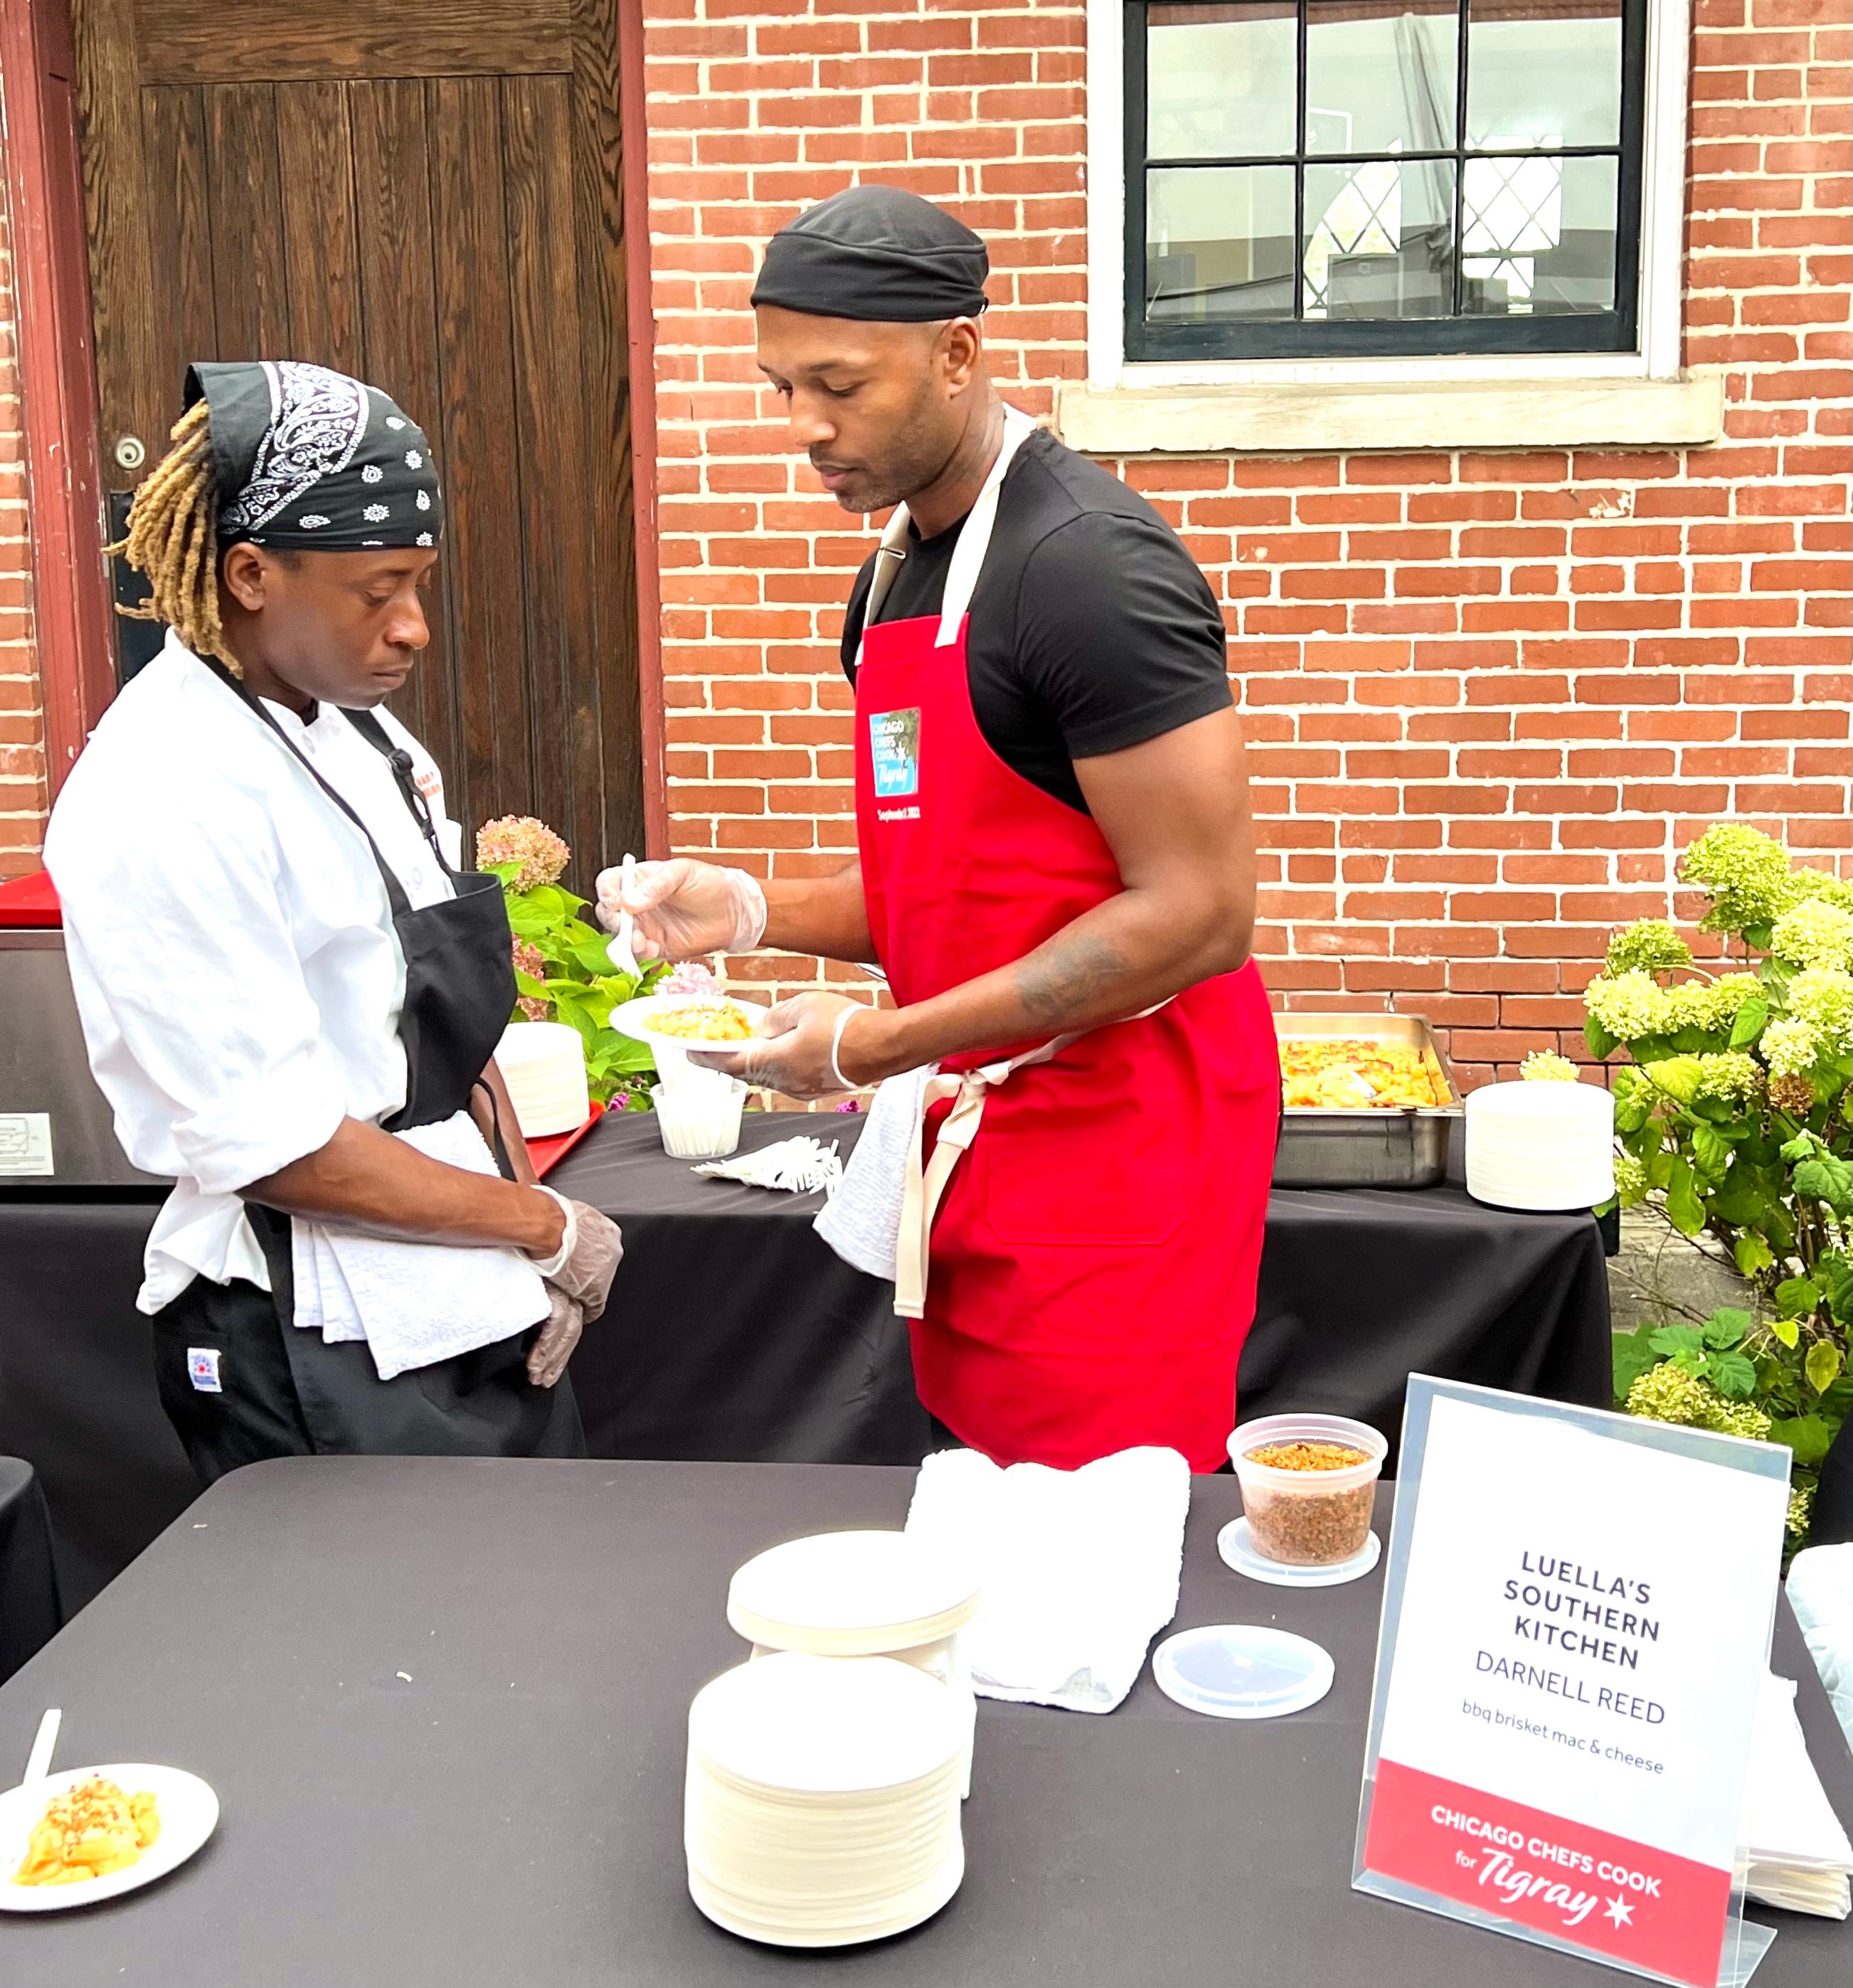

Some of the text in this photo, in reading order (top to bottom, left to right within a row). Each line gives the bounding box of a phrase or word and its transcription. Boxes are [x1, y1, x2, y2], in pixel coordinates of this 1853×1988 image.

[1504, 1580, 1660, 1642] SOUTHERN
[1522, 1551, 1651, 1605] LUELLA'S
[1514, 1615, 1638, 1670] KITCHEN
[1476, 1650, 1664, 1724] DARNELL REED
[1462, 1699, 1664, 1774] bbq brisket mac & cheese
[1431, 1804, 1662, 1898] CHICAGO CHEFS COOK
[1455, 1847, 1598, 1926] for Tigray
